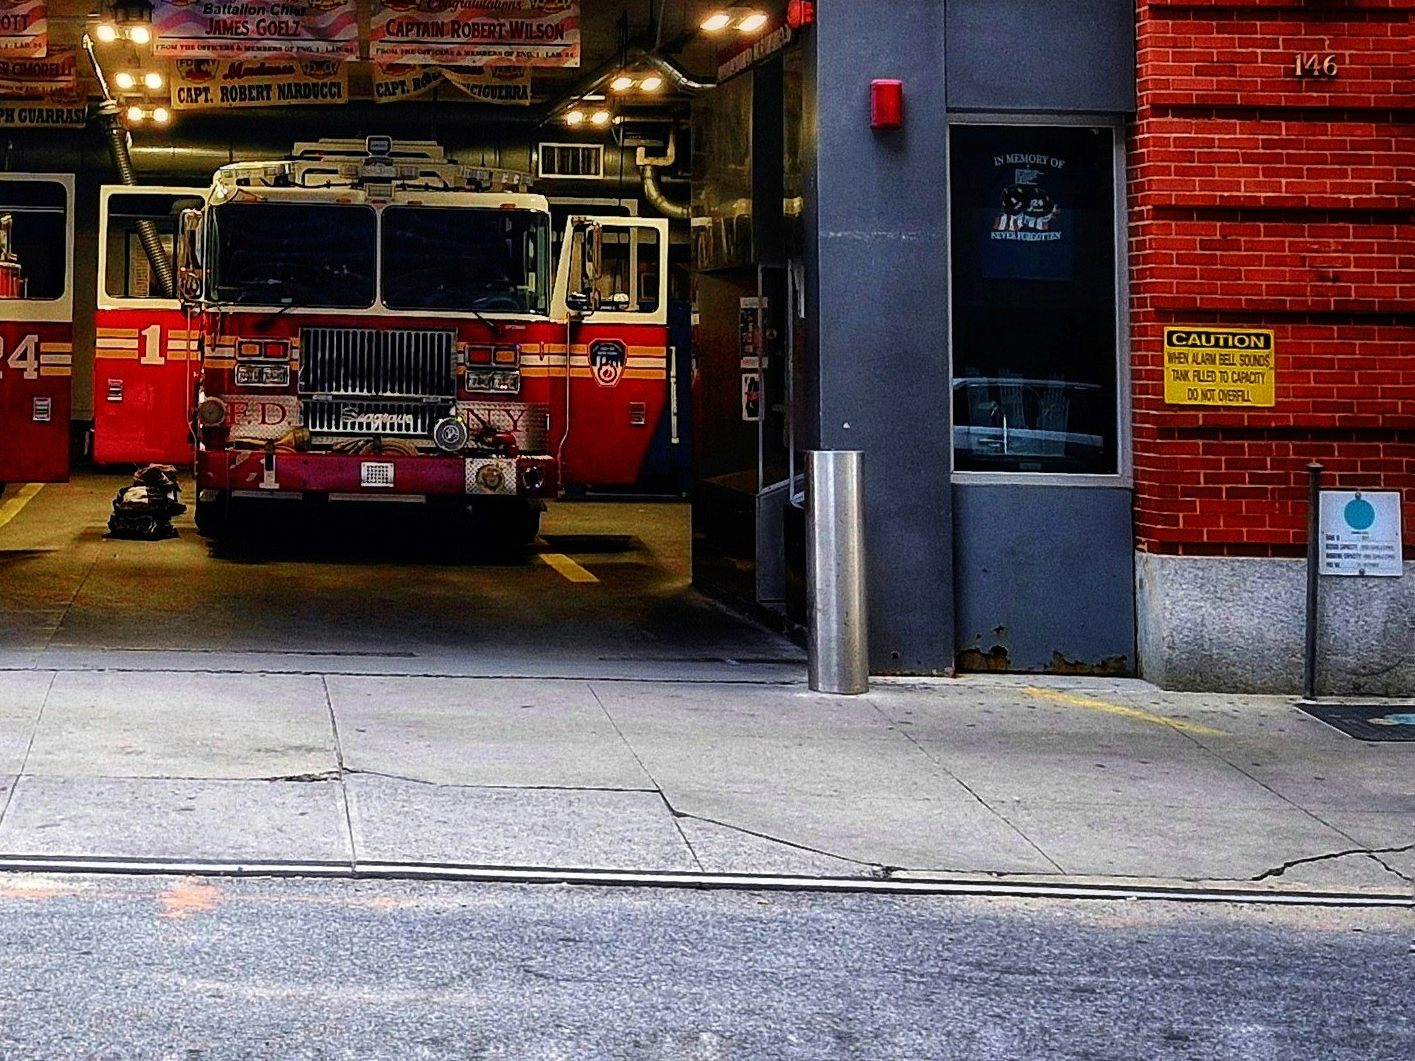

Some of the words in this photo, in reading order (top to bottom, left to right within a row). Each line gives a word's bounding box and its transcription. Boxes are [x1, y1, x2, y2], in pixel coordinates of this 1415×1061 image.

[202, 3, 266, 16] Battalion
[205, 19, 250, 37] JAMES
[255, 19, 301, 37] GOELZ
[386, 19, 445, 38] CAPTAIN
[450, 20, 505, 39] ROBERT
[508, 21, 565, 40] WILSON
[1294, 53, 1338, 76] 146
[177, 86, 214, 104] CAPT.
[220, 83, 273, 103] ROBERT
[277, 81, 343, 100] NARDUCCI
[376, 79, 409, 98] CAPT.
[994, 155, 1004, 166] IN
[1006, 153, 1049, 165] MEMORY
[1050, 157, 1065, 169] OF
[991, 231, 1016, 240] NEVER
[1017, 231, 1062, 241] FORGOTTEN
[140, 324, 165, 365] 1
[1172, 332, 1265, 348] CAUTION
[1167, 351, 1189, 365] WHEN
[1191, 352, 1217, 366] ALARM
[1218, 353, 1237, 366] BELL
[1239, 354, 1270, 368] SOUNDS
[1171, 369, 1191, 382] TANK
[1192, 370, 1217, 383] FILLED
[1219, 371, 1229, 384] TO
[1231, 371, 1266, 385] CAPACITY
[1187, 388, 1199, 401] DO
[1200, 389, 1216, 402] NOT
[1218, 390, 1252, 403] OVERFILL
